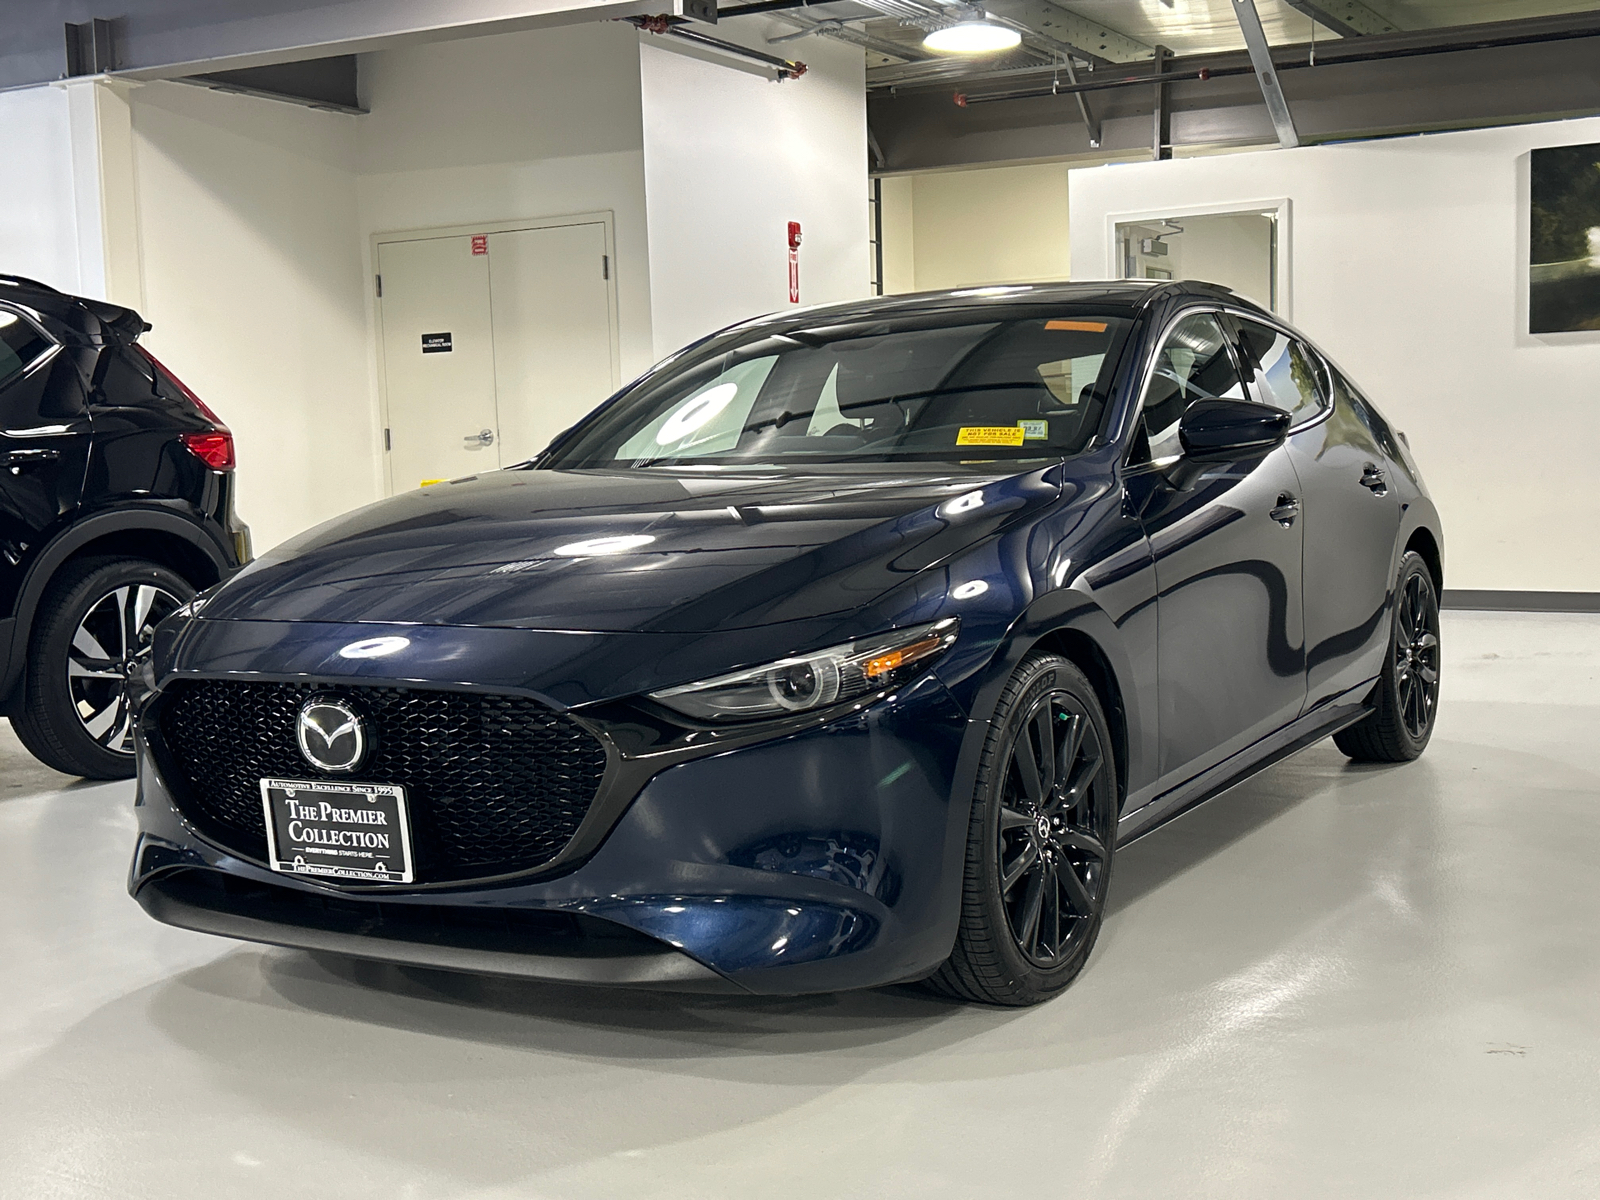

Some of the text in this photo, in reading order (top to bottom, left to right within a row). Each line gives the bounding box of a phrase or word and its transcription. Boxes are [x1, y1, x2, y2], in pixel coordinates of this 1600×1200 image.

[311, 783, 351, 793] EXCELLENCE
[352, 785, 372, 794] SINCE
[285, 799, 388, 826] THE PREMIER
[288, 820, 390, 849] COLLECTION
